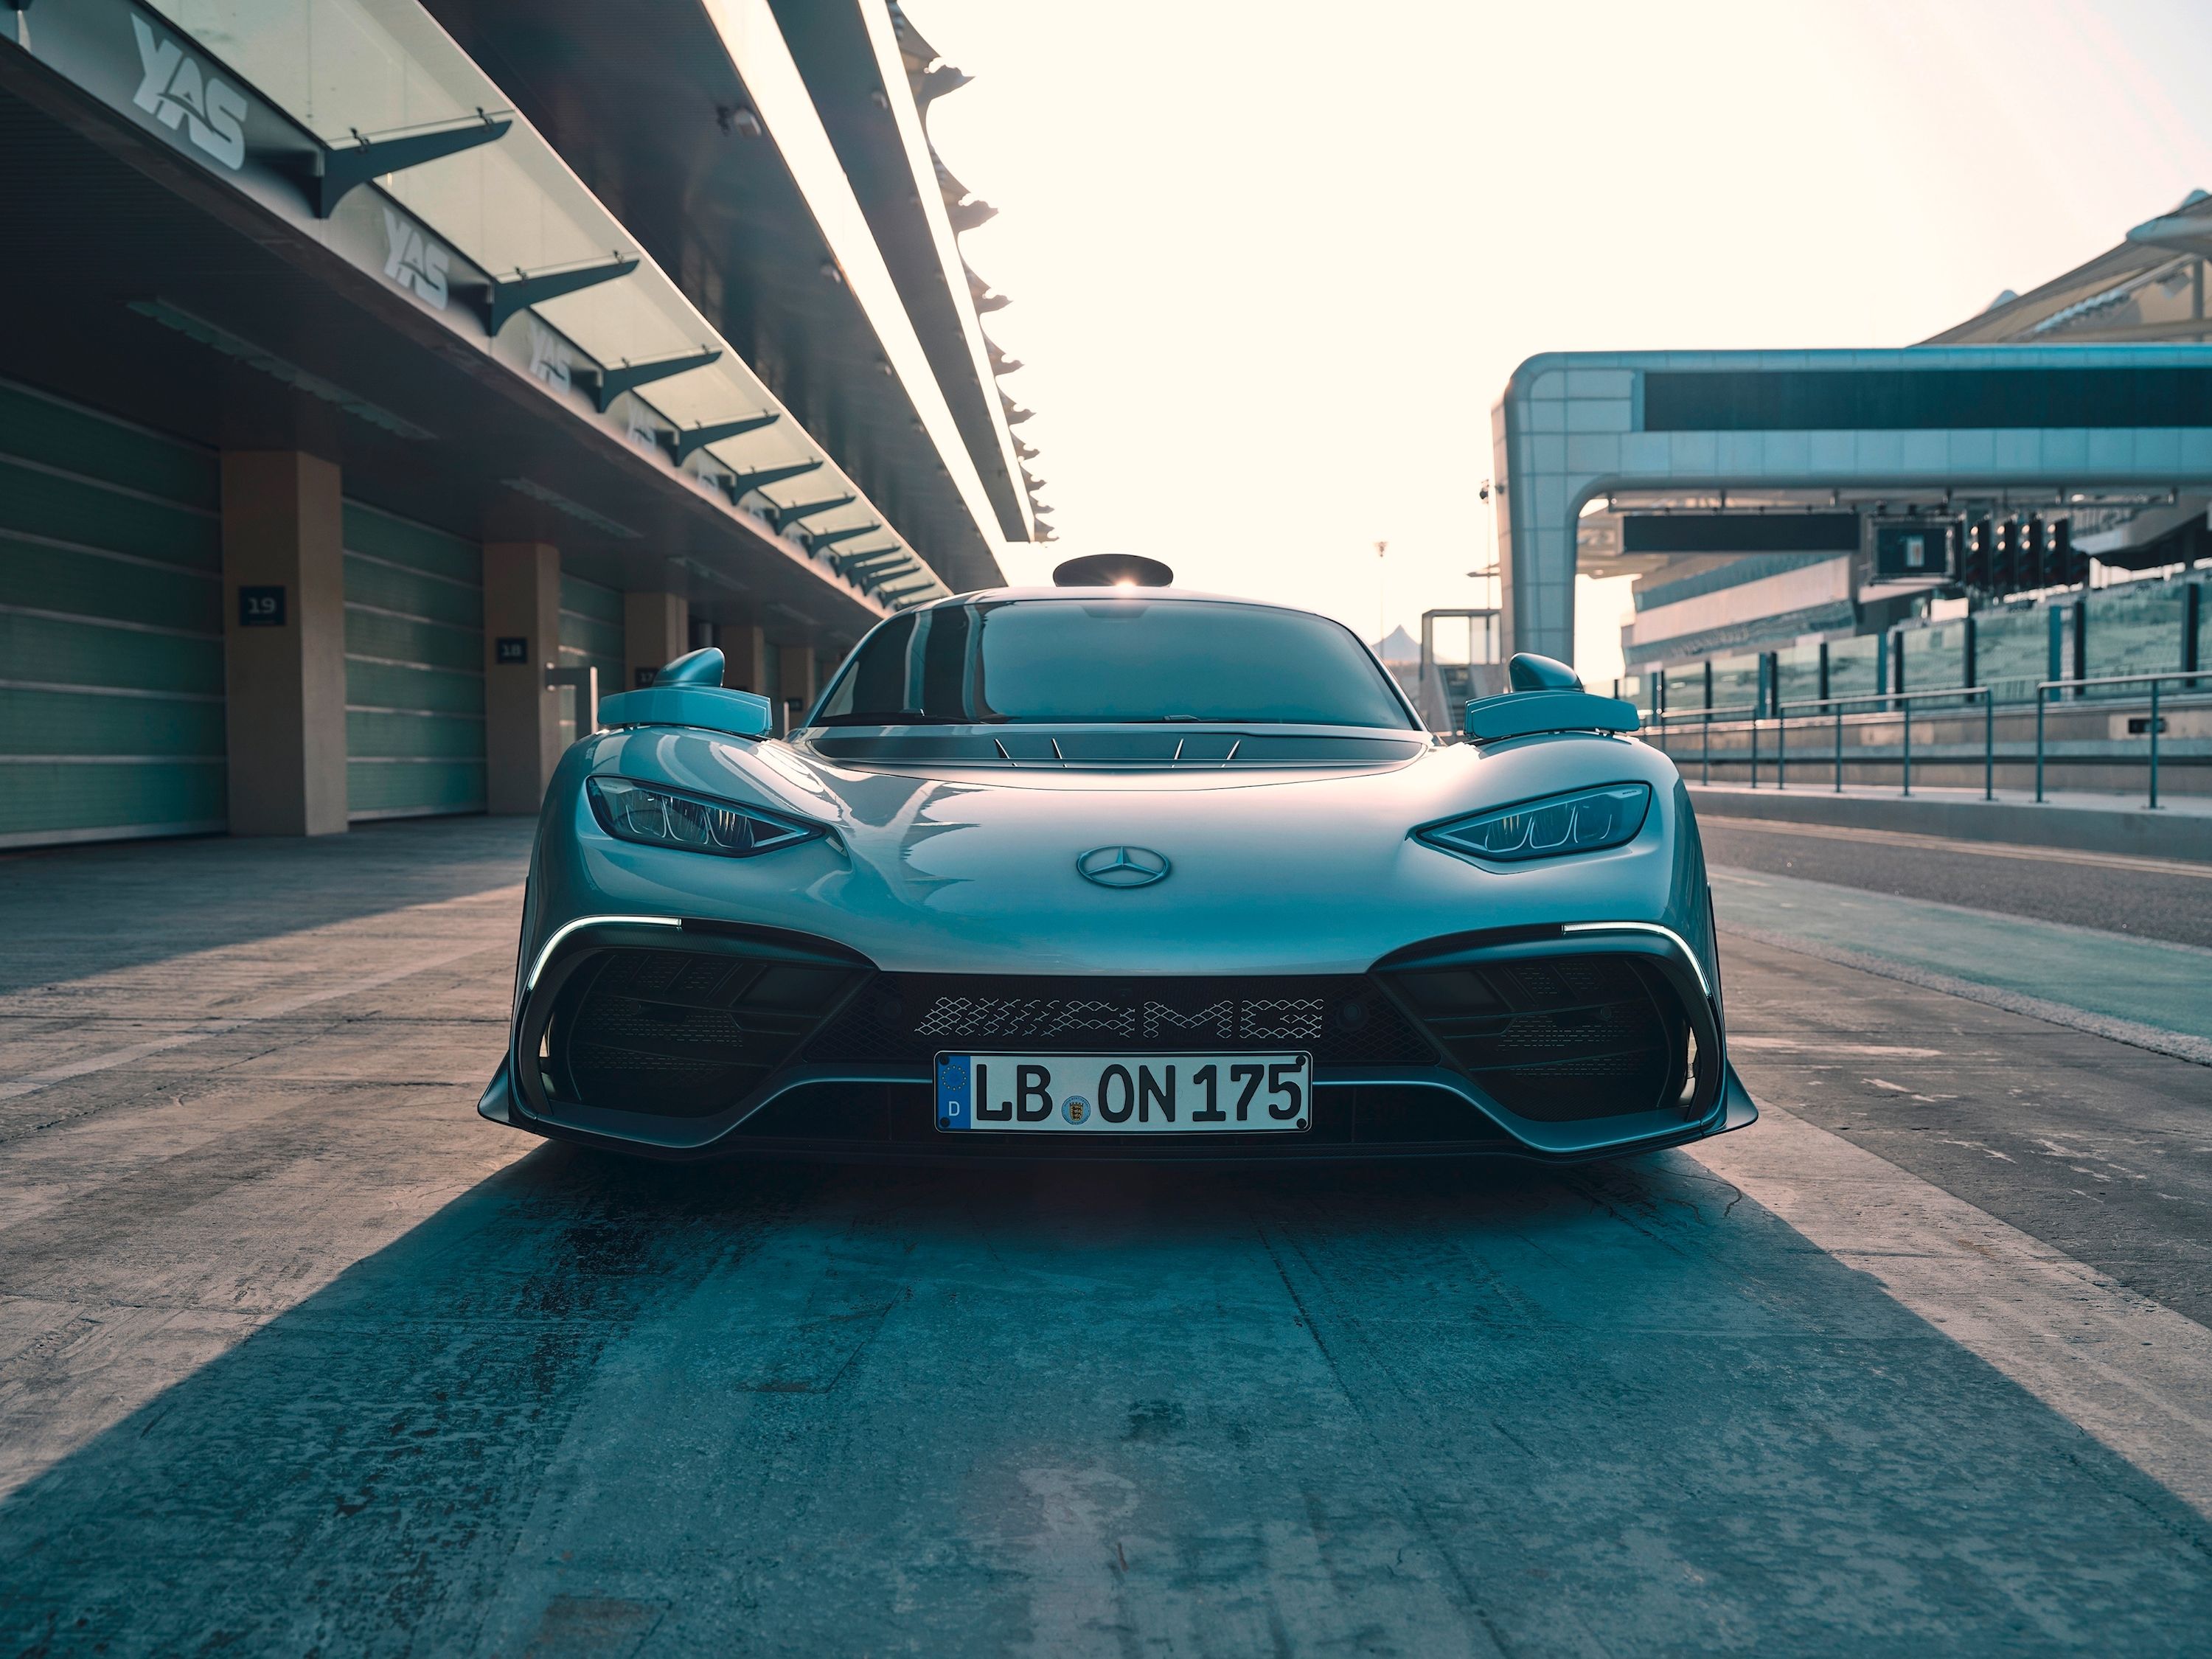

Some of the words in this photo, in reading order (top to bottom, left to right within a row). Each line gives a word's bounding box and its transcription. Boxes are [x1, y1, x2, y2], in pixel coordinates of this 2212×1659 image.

[131, 12, 248, 170] YAS
[382, 206, 450, 310] YAS
[248, 596, 276, 614] 19
[501, 644, 521, 657] 18
[1040, 998, 1324, 1039] AMG
[948, 1101, 960, 1117] D
[976, 1063, 1053, 1121] LB
[1098, 1063, 1175, 1123] ON
[1192, 1063, 1302, 1123] 175
